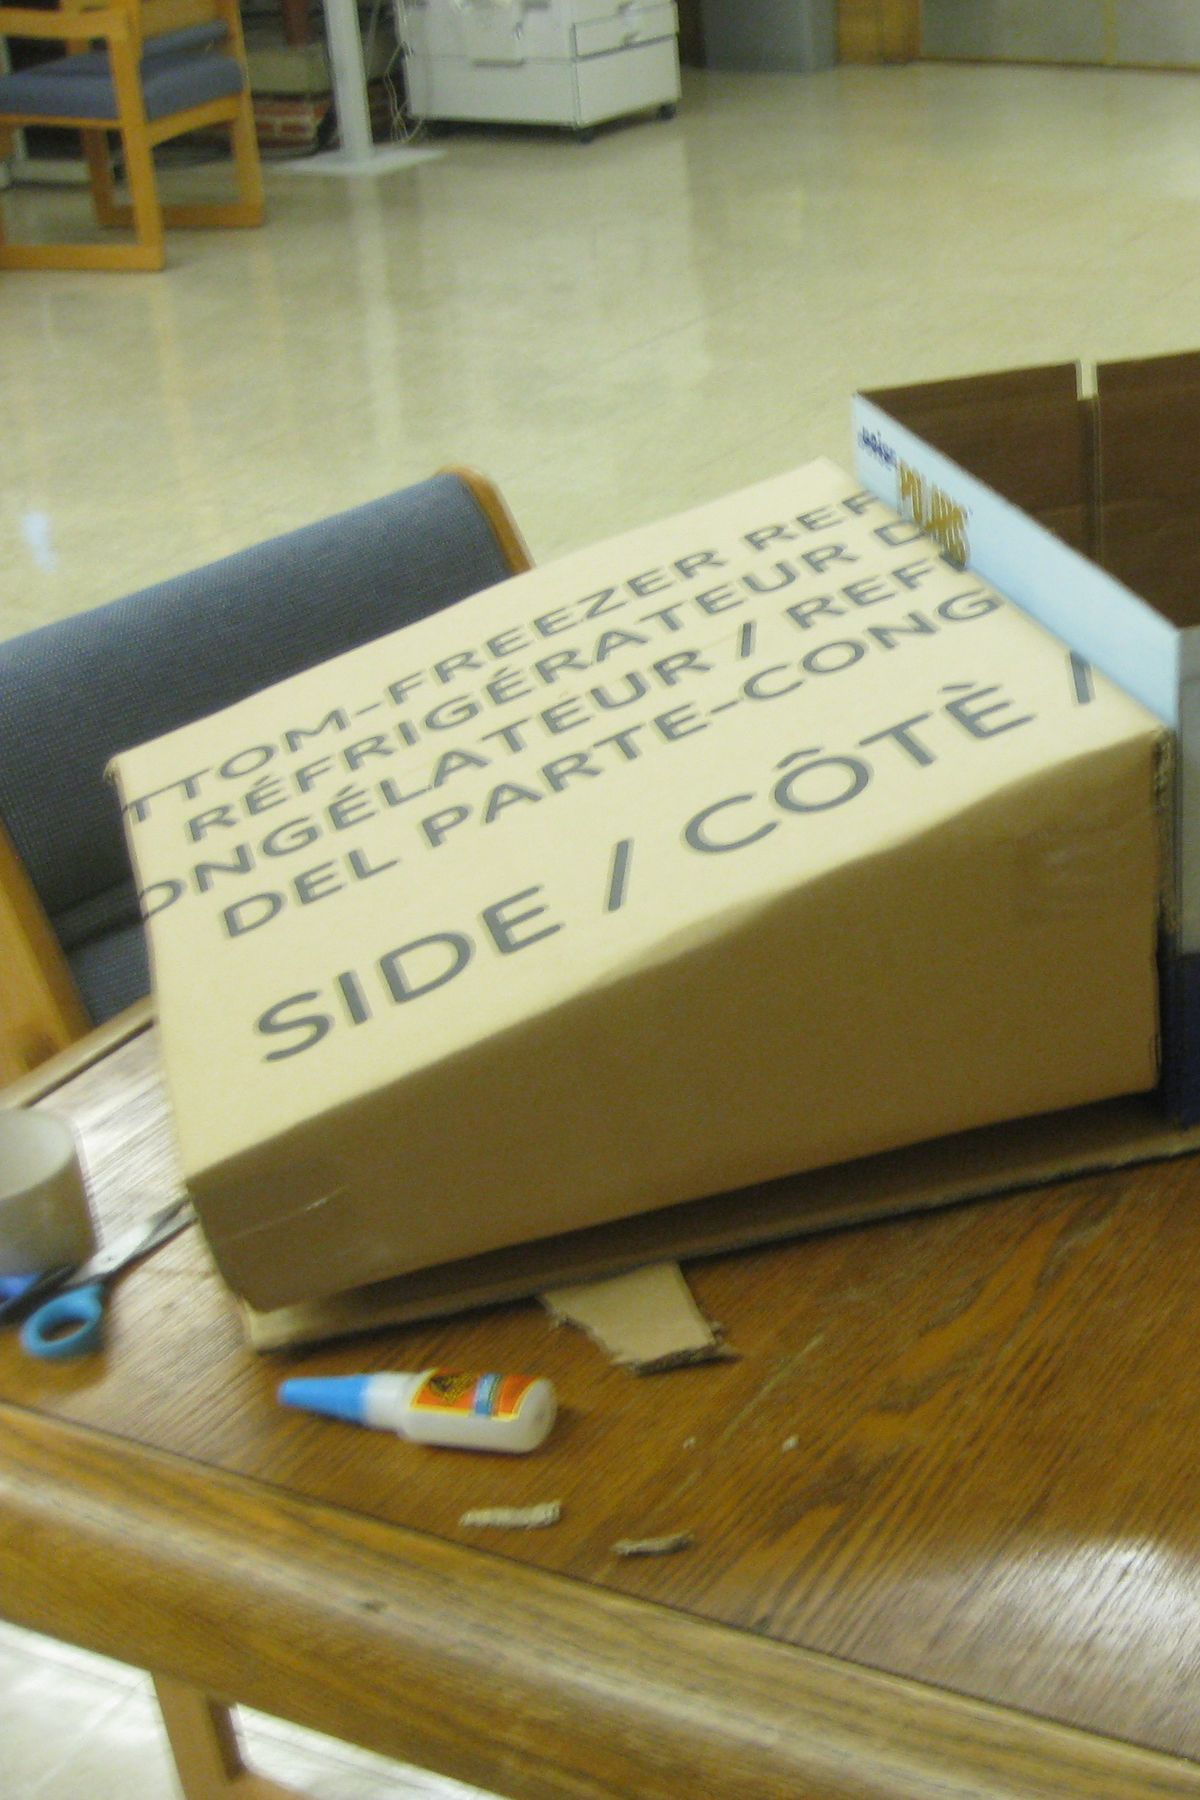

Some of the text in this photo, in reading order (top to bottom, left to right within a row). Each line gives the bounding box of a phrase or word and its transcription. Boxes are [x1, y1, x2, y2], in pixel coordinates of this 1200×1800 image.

[742, 489, 882, 551] REF
[737, 619, 757, 660] /
[222, 848, 403, 938] DEL
[256, 884, 564, 1063] SIDE
[607, 838, 634, 912] /
